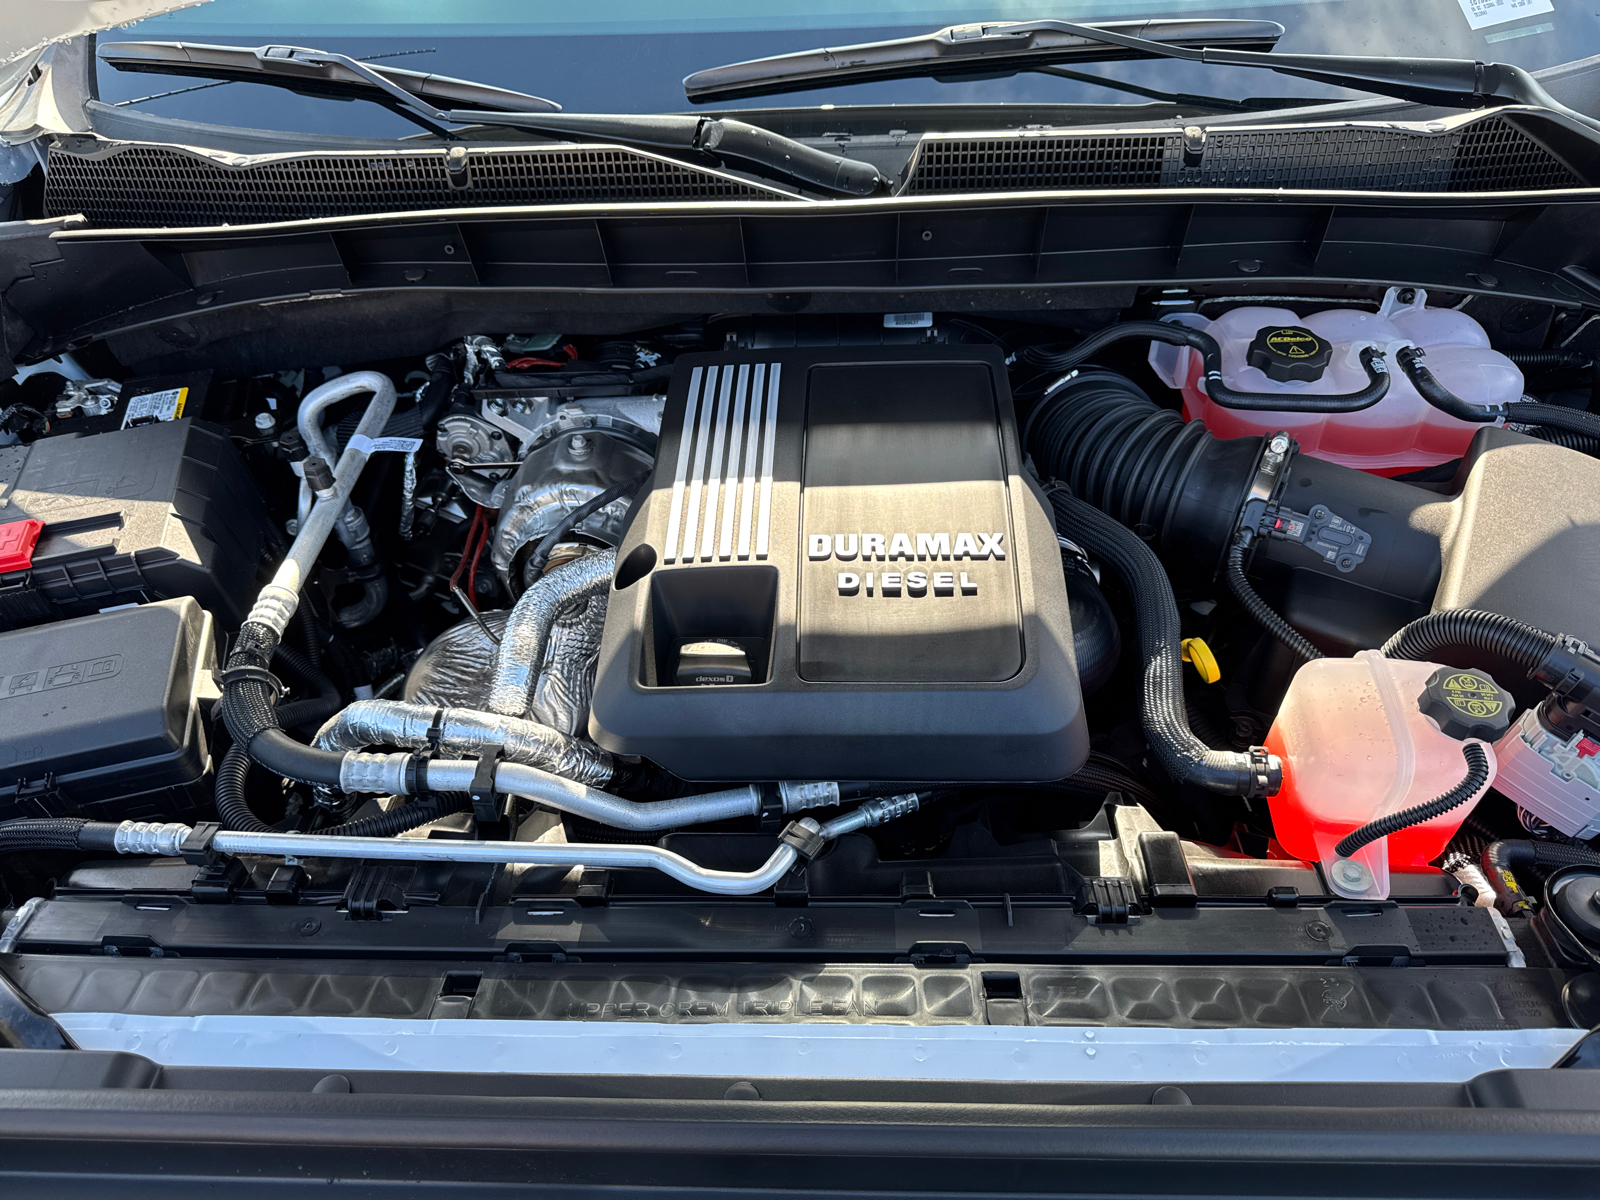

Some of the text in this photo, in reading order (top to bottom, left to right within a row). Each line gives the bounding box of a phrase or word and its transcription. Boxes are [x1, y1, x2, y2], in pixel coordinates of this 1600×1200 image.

[808, 532, 1006, 562] DURAMAX
[837, 571, 978, 598] DIESEL
[566, 1002, 650, 1019] UPPER
[737, 1001, 823, 1017] TRIPLE
[832, 1000, 879, 1017] FAN
